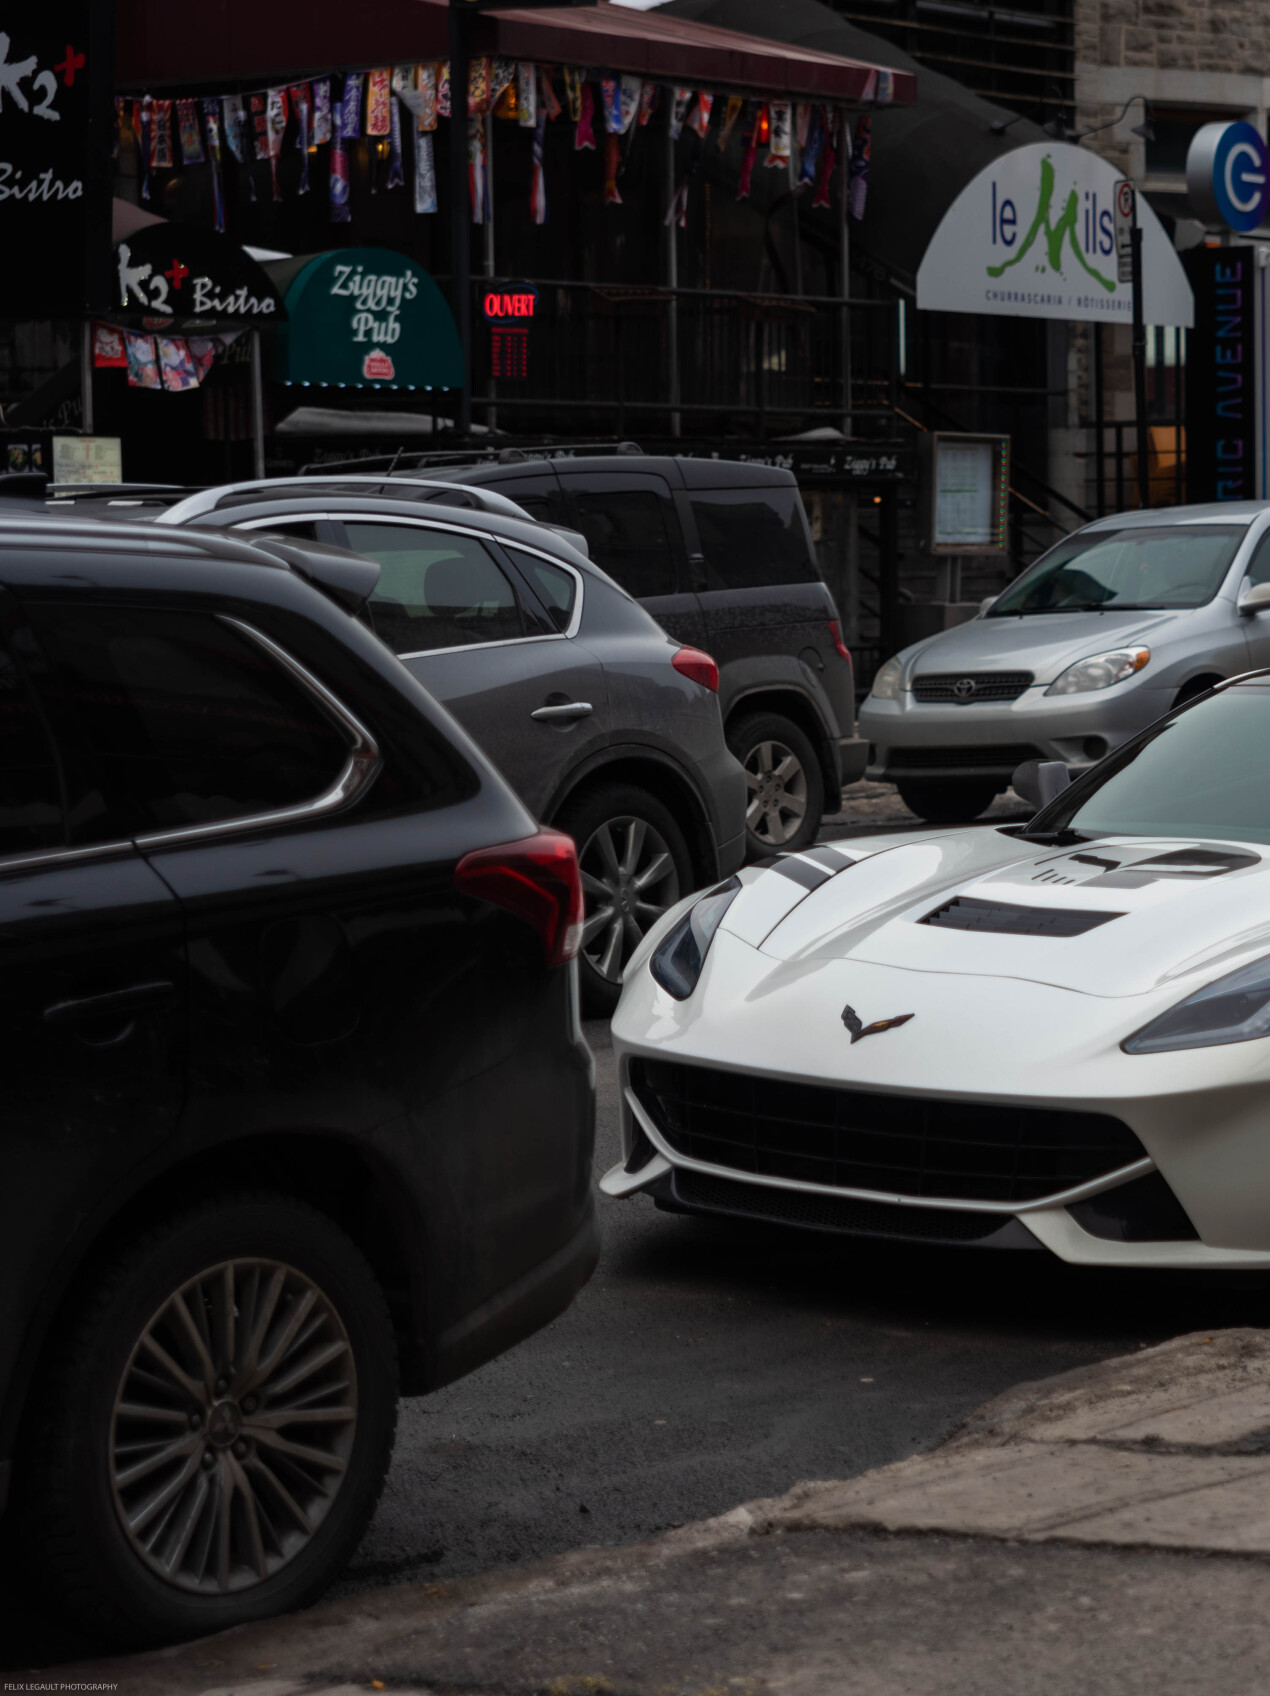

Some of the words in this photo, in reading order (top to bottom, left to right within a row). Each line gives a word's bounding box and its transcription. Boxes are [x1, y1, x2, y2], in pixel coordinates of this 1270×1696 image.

[986, 153, 1114, 293] Mils
[192, 275, 277, 315] Bistro
[329, 263, 419, 312] Ziggy's
[483, 292, 536, 317] OUVERT
[985, 289, 1063, 306] CHURRASCARIA
[351, 309, 402, 345] Pub
[1214, 259, 1244, 419] AVENUE
